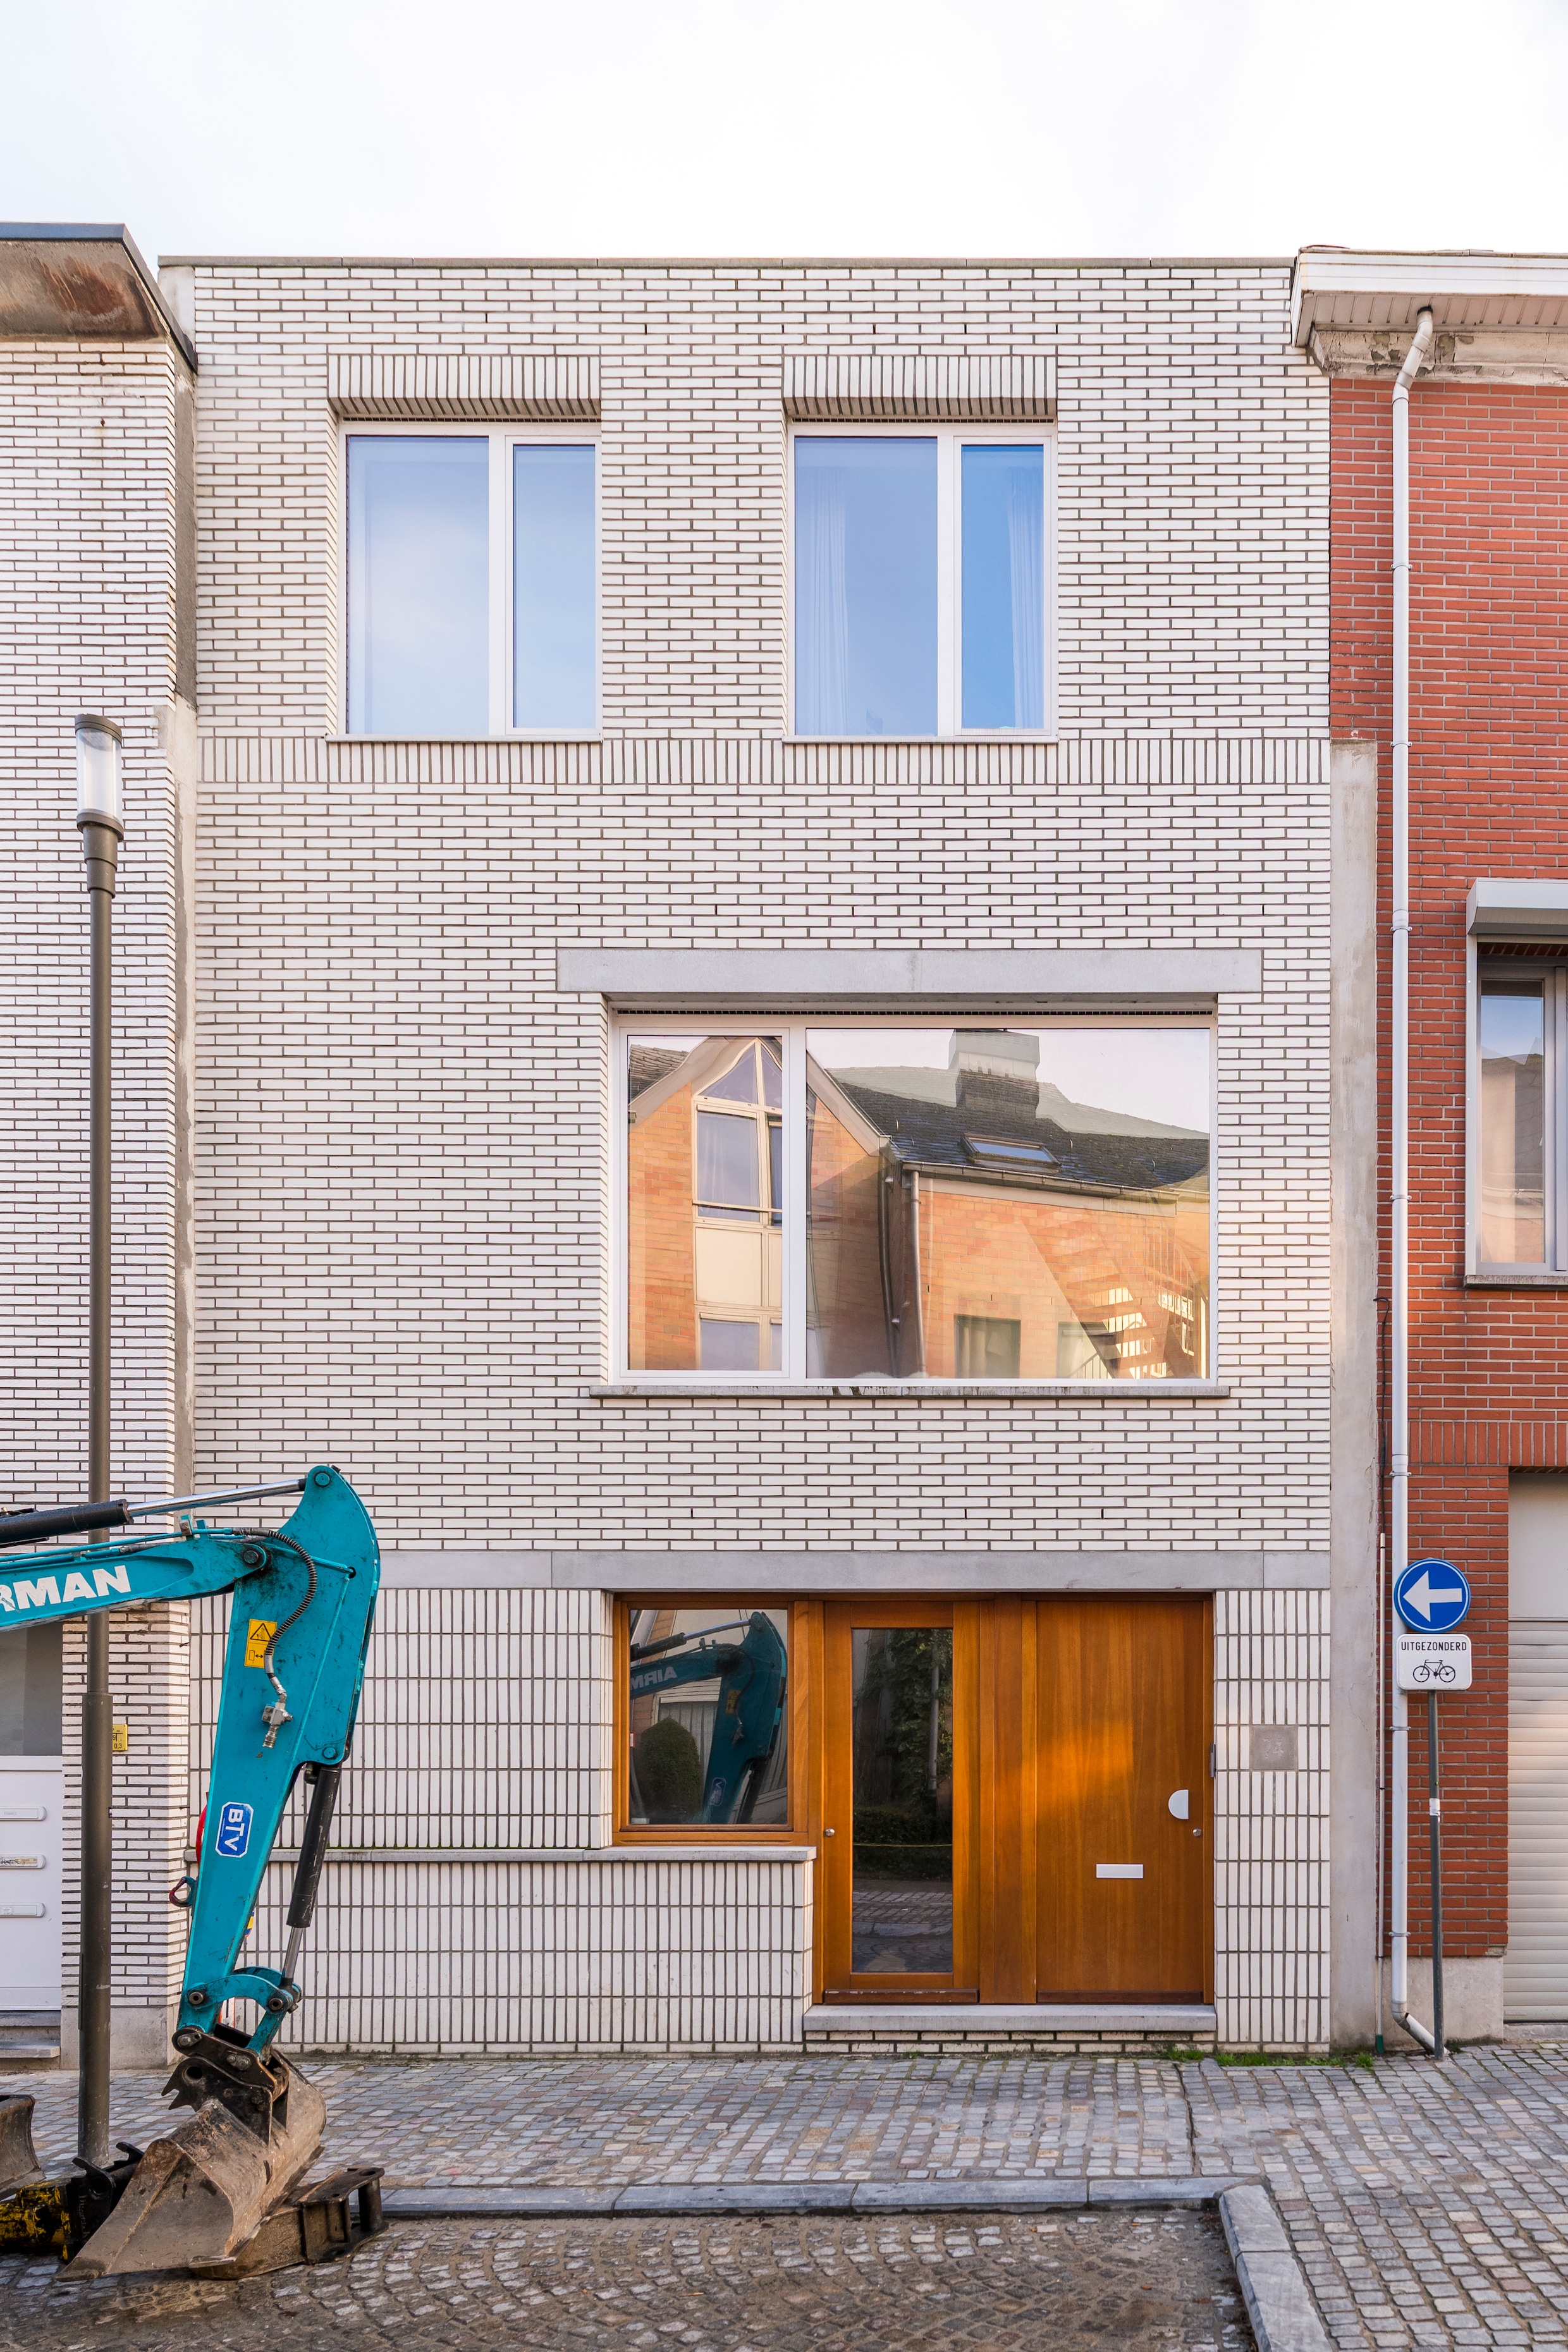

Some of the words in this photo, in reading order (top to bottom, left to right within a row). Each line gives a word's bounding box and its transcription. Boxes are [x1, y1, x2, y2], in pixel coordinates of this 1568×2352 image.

[1401, 1641, 1467, 1651] UITGEZONDERD
[1263, 1737, 1284, 1758] 74
[224, 1808, 245, 1852] BTV
